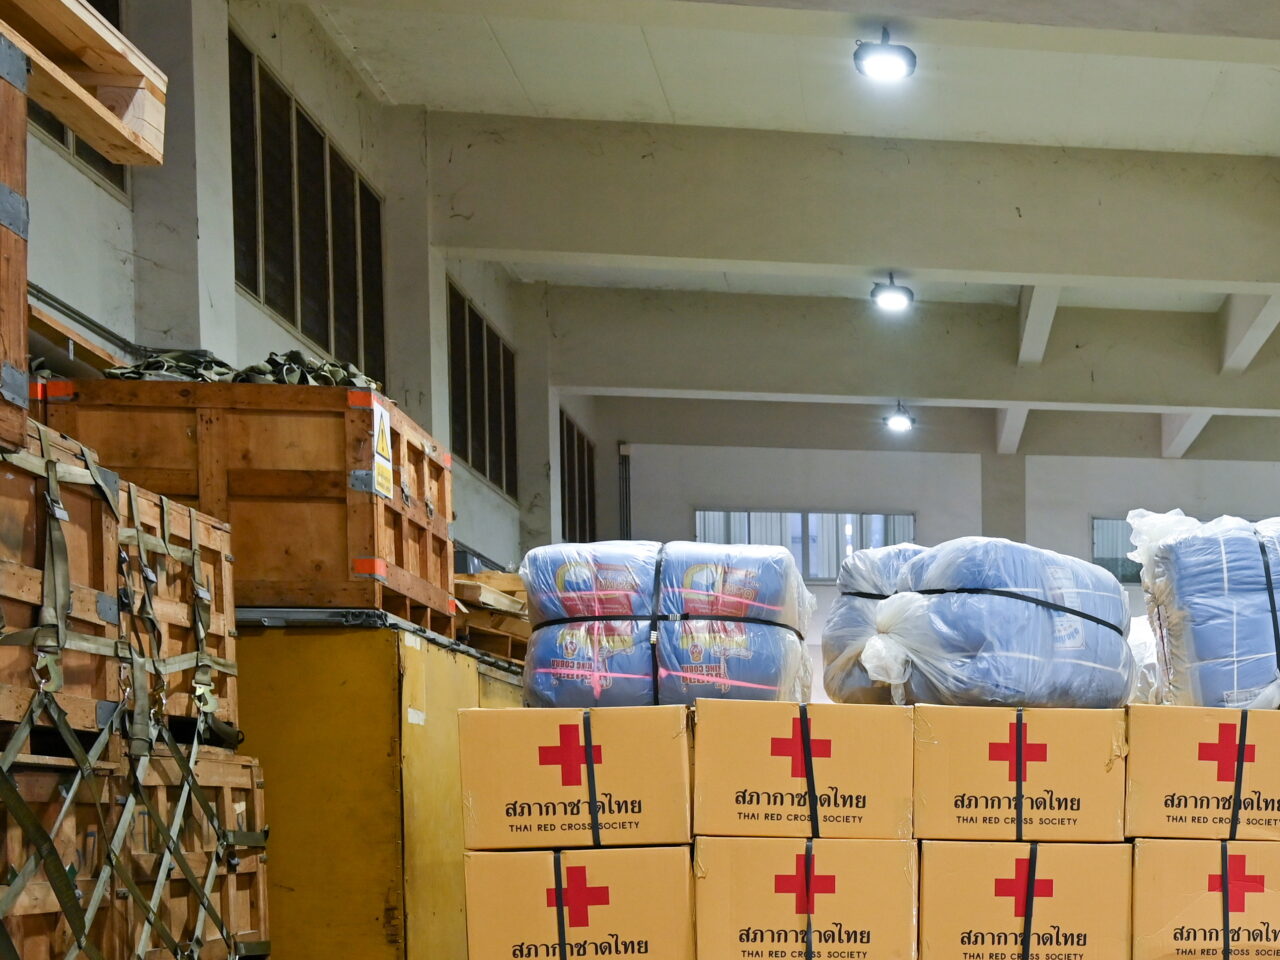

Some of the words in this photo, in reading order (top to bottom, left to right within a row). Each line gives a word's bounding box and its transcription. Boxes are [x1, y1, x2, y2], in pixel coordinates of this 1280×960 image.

[734, 785, 867, 809] สภากาชดไทย
[737, 812, 760, 821] THAI
[764, 812, 783, 821] RED
[788, 814, 814, 823] CROS
[823, 815, 864, 824] SOCIETY
[956, 815, 978, 824] THAI
[982, 816, 1000, 825] RED
[1005, 816, 1034, 825] CRSS
[1039, 817, 1078, 826] SOCIETY
[1166, 814, 1187, 823] THAI
[1191, 815, 1209, 824] RED
[1214, 816, 1242, 825] CROS
[508, 824, 532, 833] THAI
[537, 823, 557, 832] RED
[741, 949, 764, 958] THAI
[768, 950, 787, 959] RED
[827, 950, 868, 959] SOCIETY
[962, 952, 984, 960] THAI
[988, 952, 1007, 960] RED
[1011, 952, 1040, 960] CRSS
[1045, 953, 1084, 960] SOCIETY
[1175, 948, 1196, 956] THAI
[1200, 948, 1218, 956] RED
